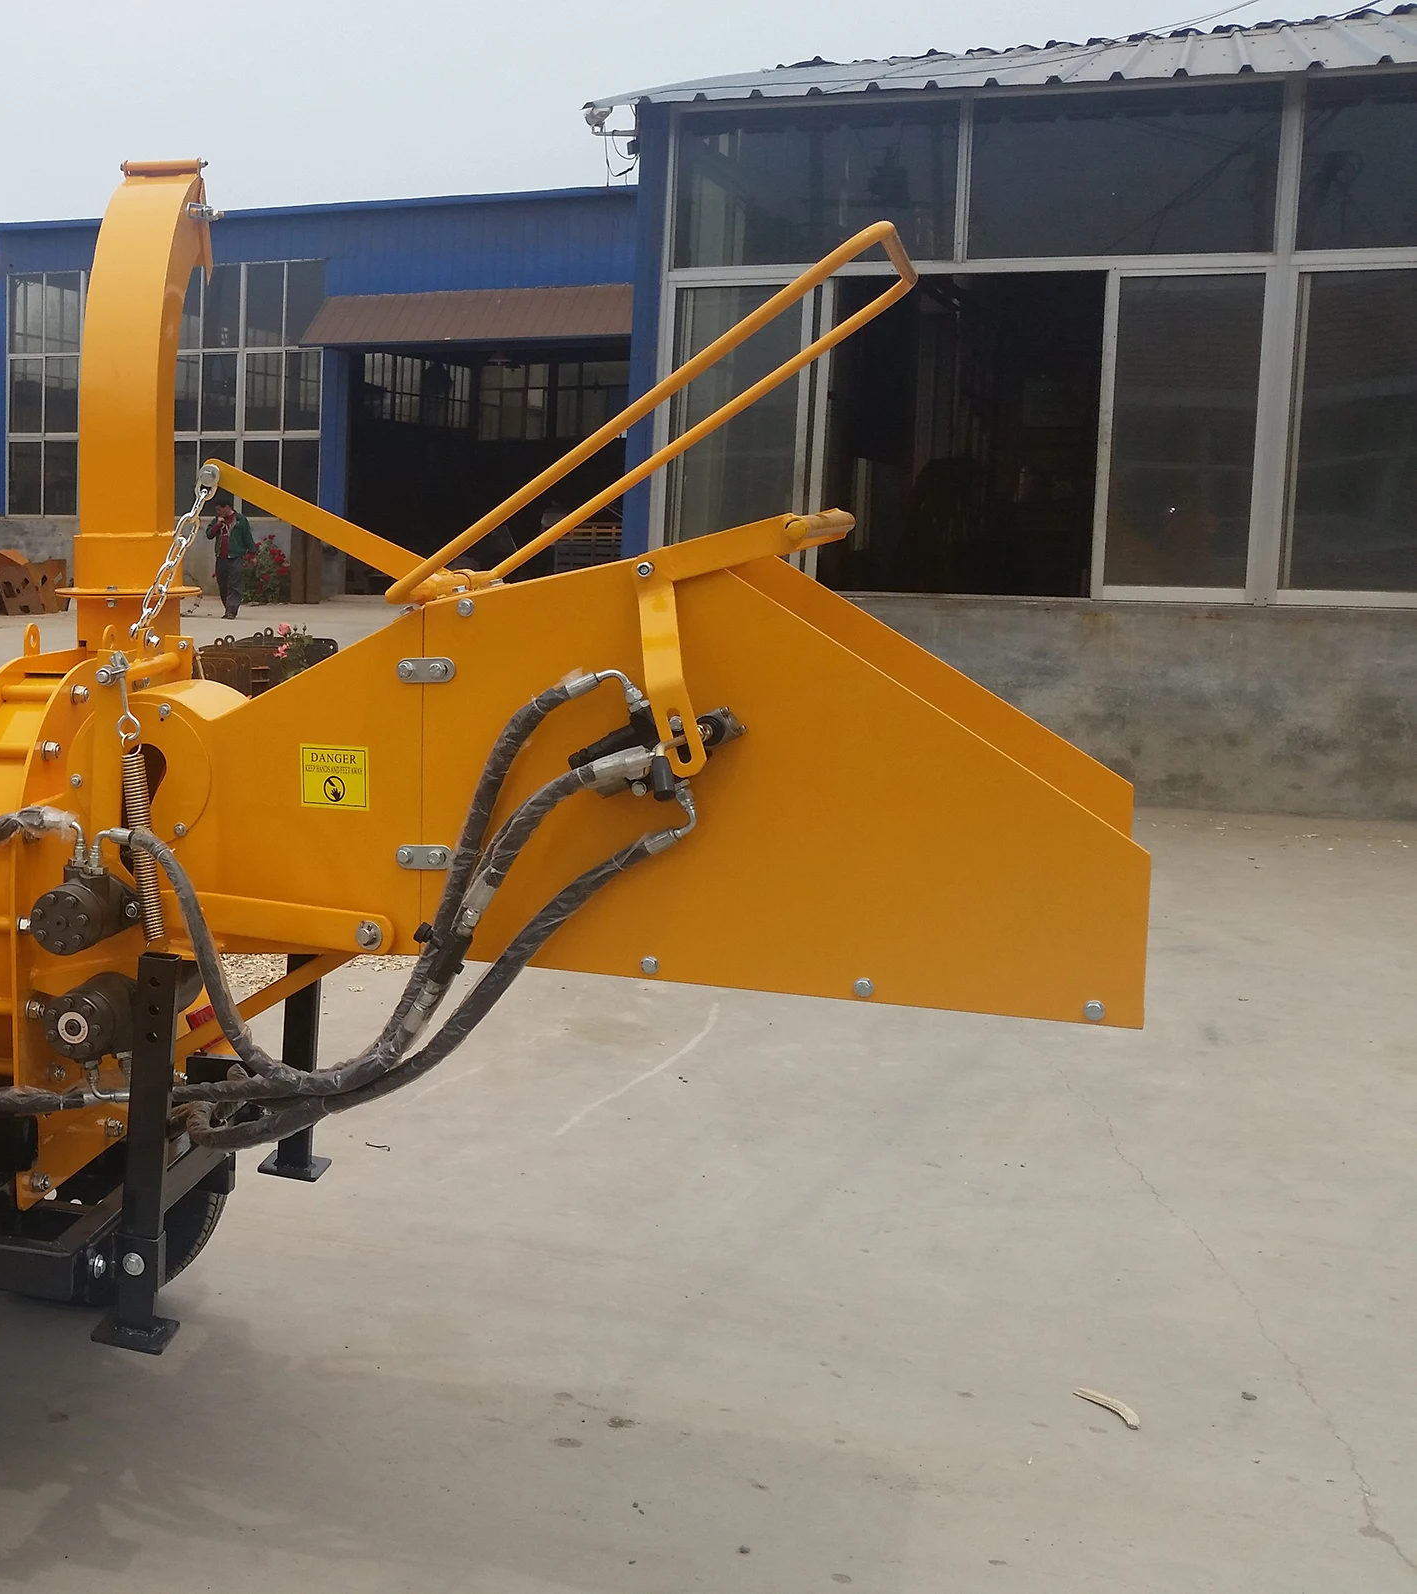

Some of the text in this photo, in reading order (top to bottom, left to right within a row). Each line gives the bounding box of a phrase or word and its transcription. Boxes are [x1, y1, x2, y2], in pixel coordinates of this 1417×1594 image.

[311, 752, 356, 764] DANGER
[305, 764, 315, 772] KEEP
[316, 765, 330, 773] HANDS
[331, 766, 339, 774] AND
